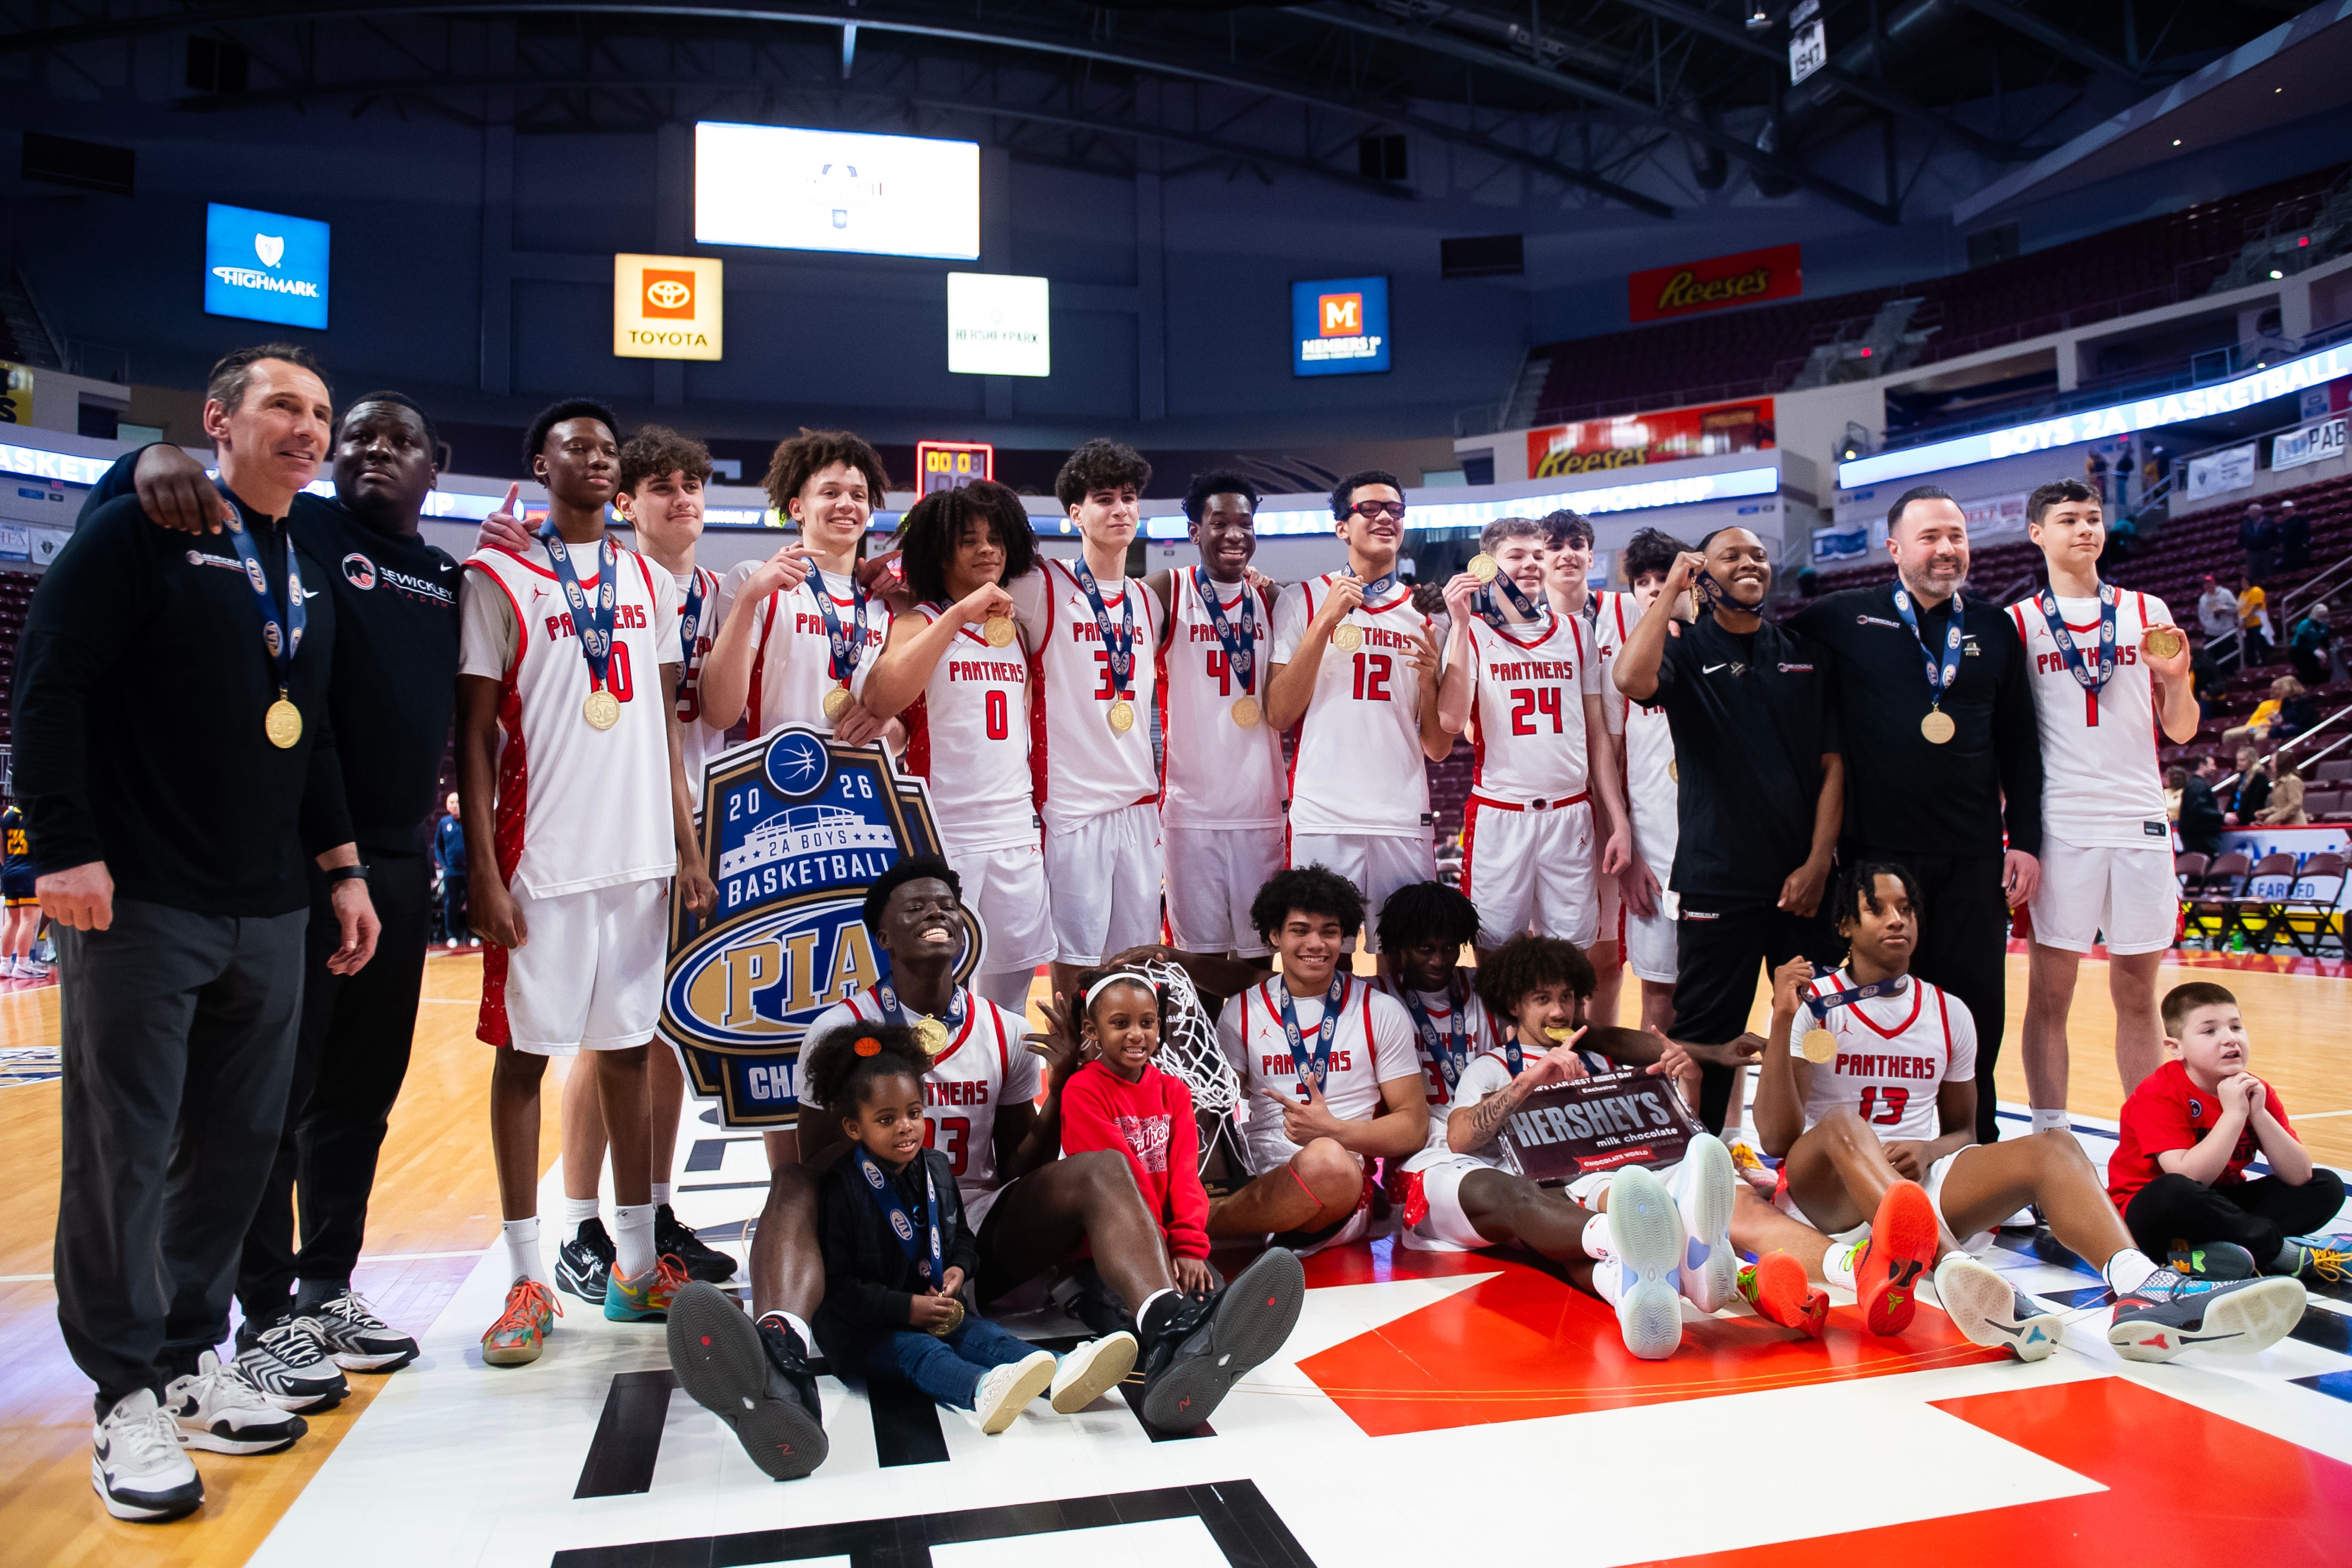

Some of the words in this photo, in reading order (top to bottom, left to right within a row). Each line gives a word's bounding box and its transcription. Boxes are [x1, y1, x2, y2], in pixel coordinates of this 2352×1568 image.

[213, 267, 319, 297] HIGHMARK
[628, 329, 708, 347] TOYOTA
[955, 328, 1038, 344] HERSHEYPARK
[1302, 337, 1368, 355] MEMBERS
[1990, 423, 2073, 459] BOYS
[2081, 407, 2124, 434] 2A
[2136, 350, 2350, 428] BASKETBALL
[380, 567, 453, 600] SEWICKLEY
[381, 582, 448, 608] ACADEM
[545, 604, 646, 641] PAERS
[1330, 625, 1412, 650] THERS
[950, 661, 1024, 684] PANTHERS
[1352, 653, 1392, 701] 12
[1490, 660, 1573, 682] PANTHERS
[985, 690, 1009, 740] 0
[1510, 687, 1563, 736] 24
[730, 787, 760, 821] 20
[840, 774, 873, 800] 26
[769, 841, 790, 857] 2A
[801, 831, 847, 850] BOYS
[720, 919, 883, 1026] PIA
[1262, 1050, 1352, 1076] PANRS
[1616, 1071, 1632, 1079] Bar
[1835, 1054, 1935, 1079] PANTHERS
[925, 1080, 988, 1107] THERS
[1581, 1084, 1618, 1094] Exclusive
[1472, 1093, 1509, 1132] Mom
[1858, 1086, 1910, 1125] 13
[1509, 1092, 1670, 1148] HERSHEY'S
[1596, 1135, 1621, 1148] milk
[1623, 1126, 1678, 1143] chocolate
[1583, 1153, 1624, 1168] CHOCOLATE
[1622, 1149, 1649, 1161] WORLD
[865, 1163, 883, 1188] PIAA
[893, 1212, 912, 1239] PIAA
